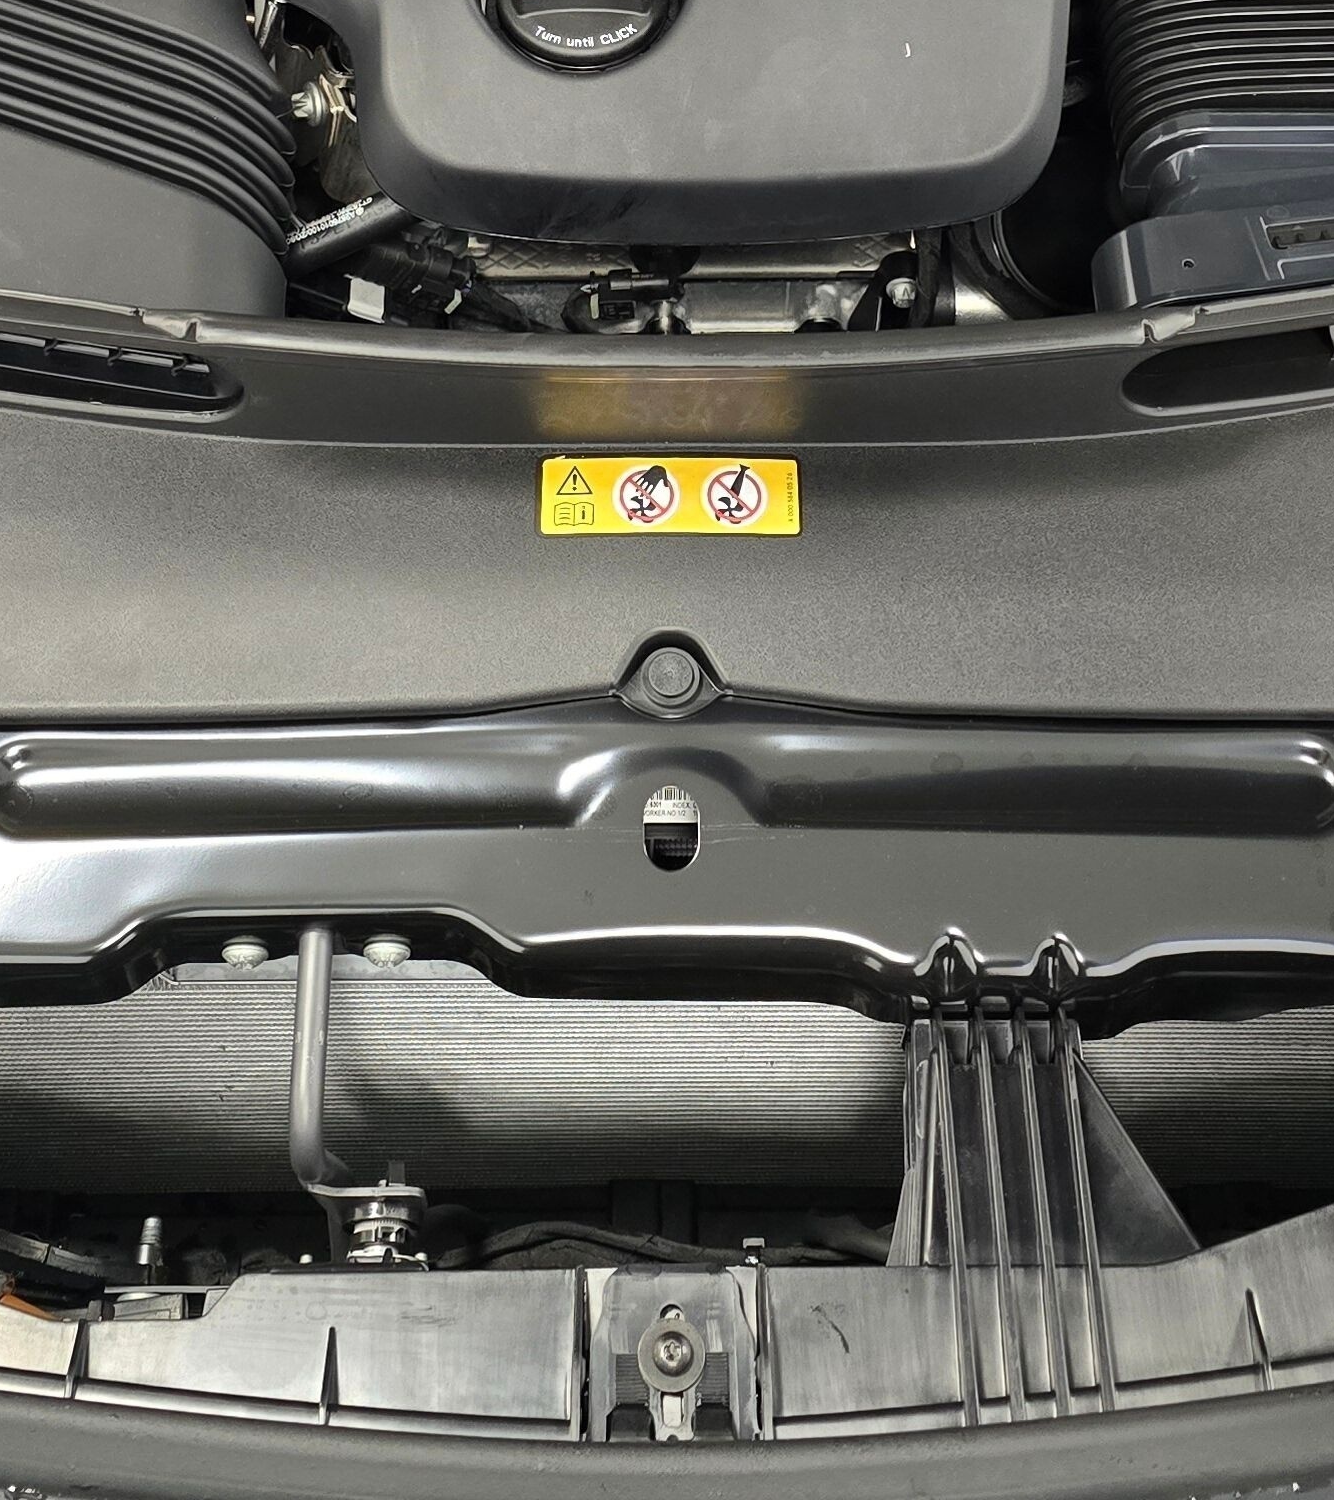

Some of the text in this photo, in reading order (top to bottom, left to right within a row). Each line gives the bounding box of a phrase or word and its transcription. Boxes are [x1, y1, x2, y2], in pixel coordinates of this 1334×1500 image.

[534, 23, 638, 48] Turn until CLICK
